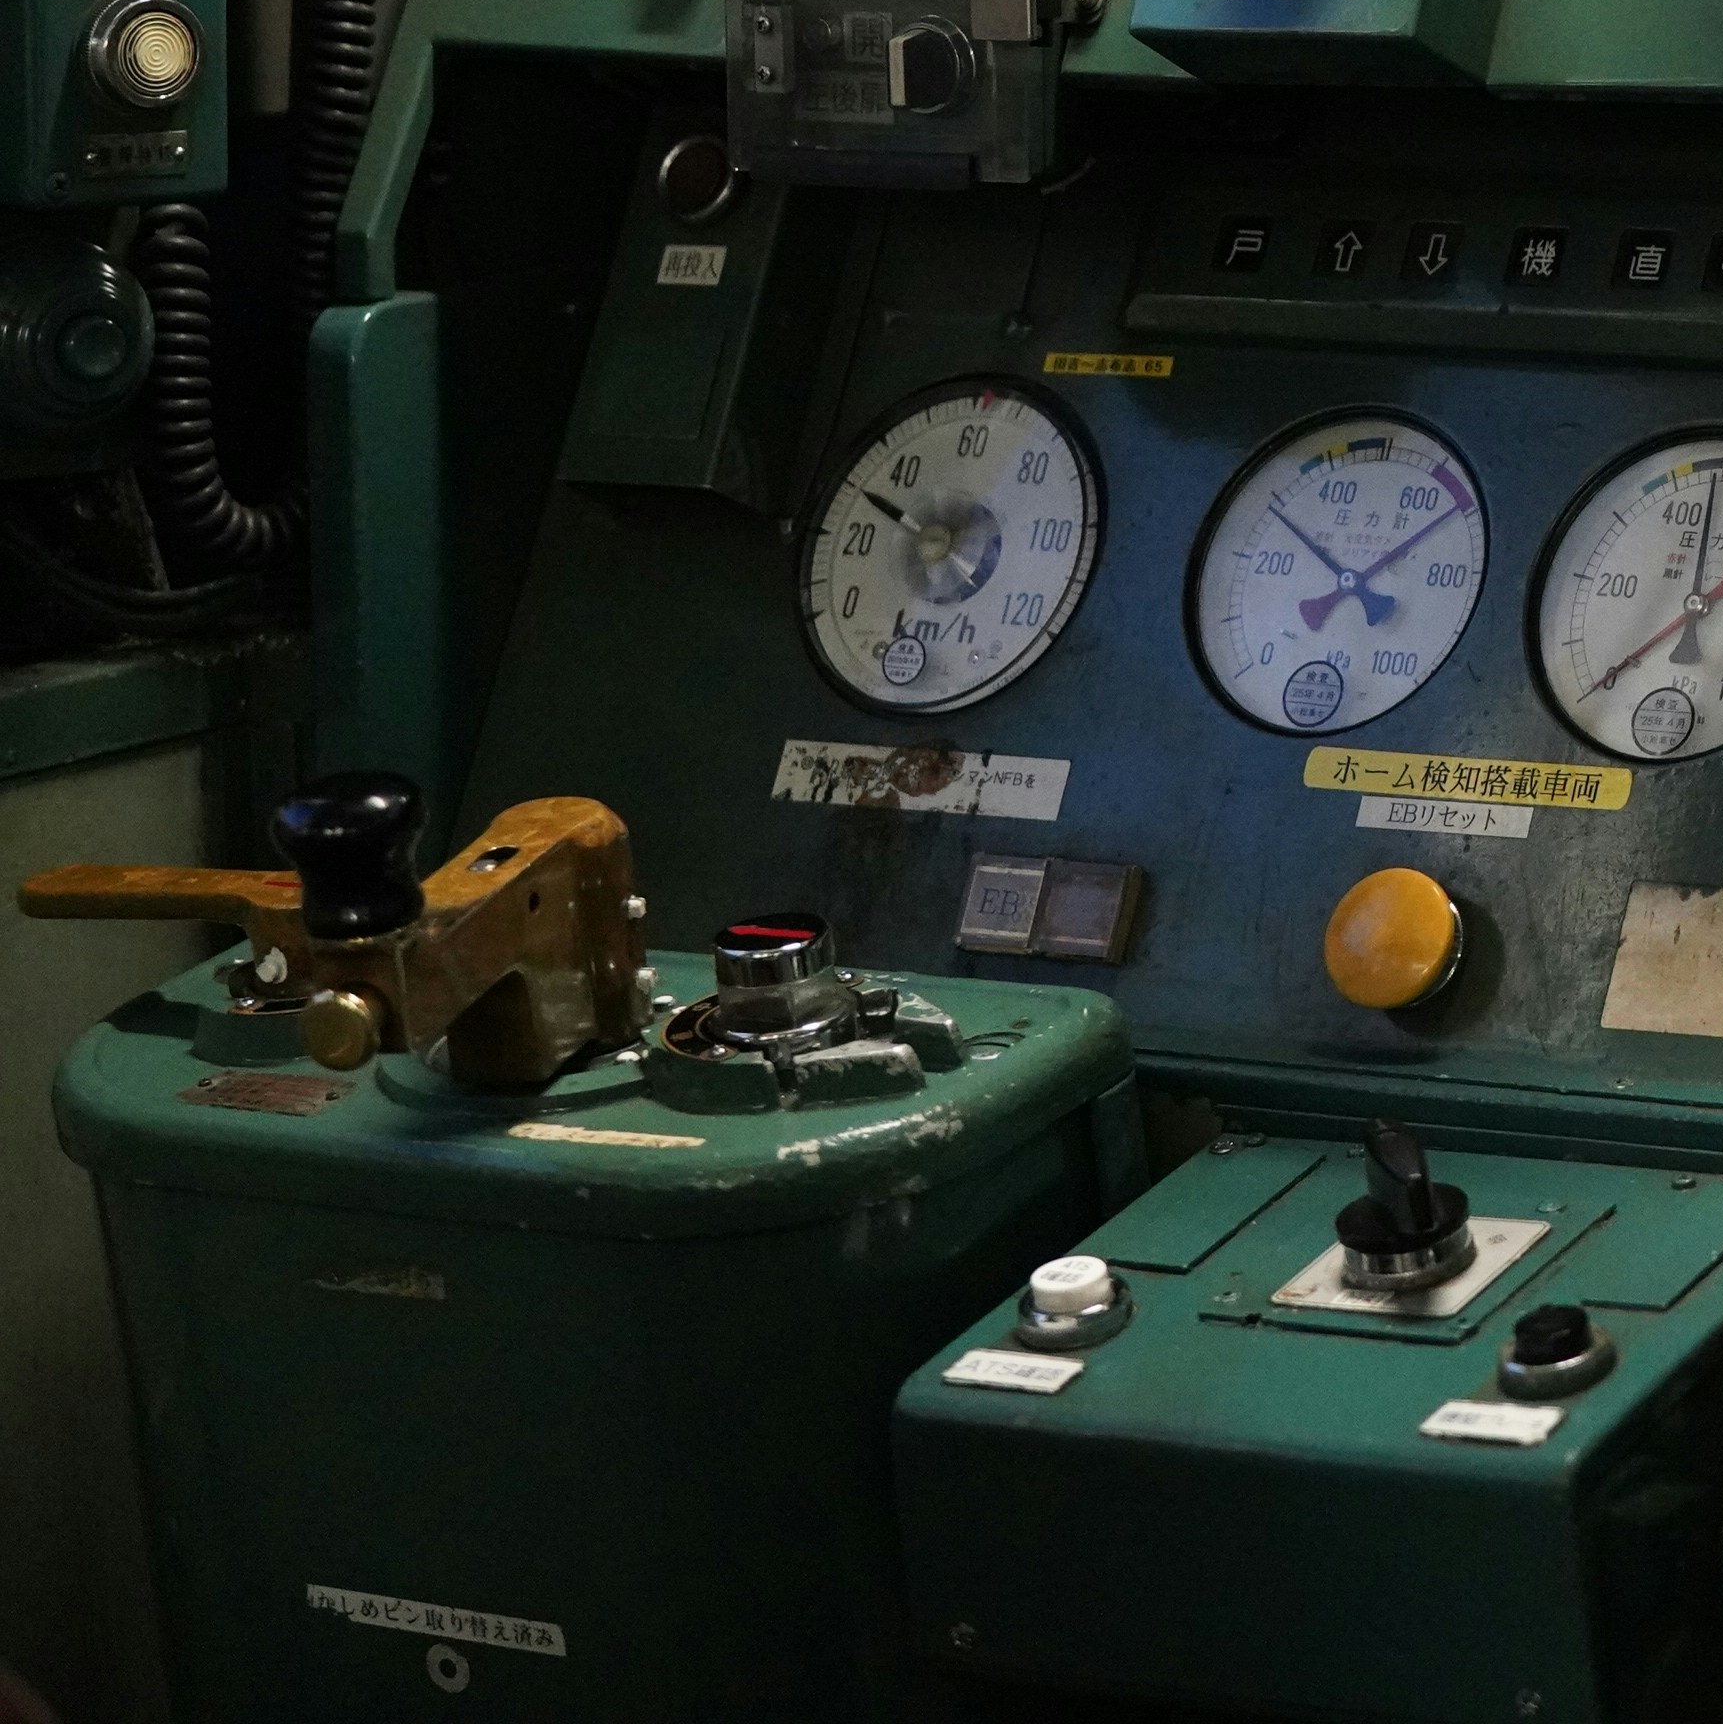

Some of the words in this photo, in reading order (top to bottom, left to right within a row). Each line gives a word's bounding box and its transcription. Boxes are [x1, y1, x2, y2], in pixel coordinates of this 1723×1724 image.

[1224, 230, 1264, 266] 戸
[1520, 239, 1557, 278] 機
[1628, 244, 1663, 282] 直
[1144, 358, 1163, 373] 65
[957, 424, 989, 458] 60
[889, 455, 921, 489] 40
[1017, 451, 1050, 485] 80
[1318, 480, 1358, 505] 400
[1399, 486, 1440, 511] 600
[1334, 509, 1410, 530] 圧力計
[1661, 501, 1704, 527] 400
[842, 522, 876, 557] 20
[1028, 518, 1074, 554] 100
[1254, 550, 1295, 576] 200
[1426, 563, 1468, 589] 800
[1595, 573, 1639, 600] 200
[842, 585, 860, 620] 0
[1000, 592, 1045, 628] 120
[892, 608, 977, 645] km/h
[1259, 642, 1275, 665] 0
[1371, 650, 1419, 677] 1000
[1602, 666, 1618, 691] 0
[1671, 675, 1698, 696] kPa
[1655, 698, 1680, 711] 検査
[1332, 754, 1604, 804] ホーム検知搭載車両
[1385, 801, 1498, 832] EBリセット
[978, 887, 1021, 919] EB
